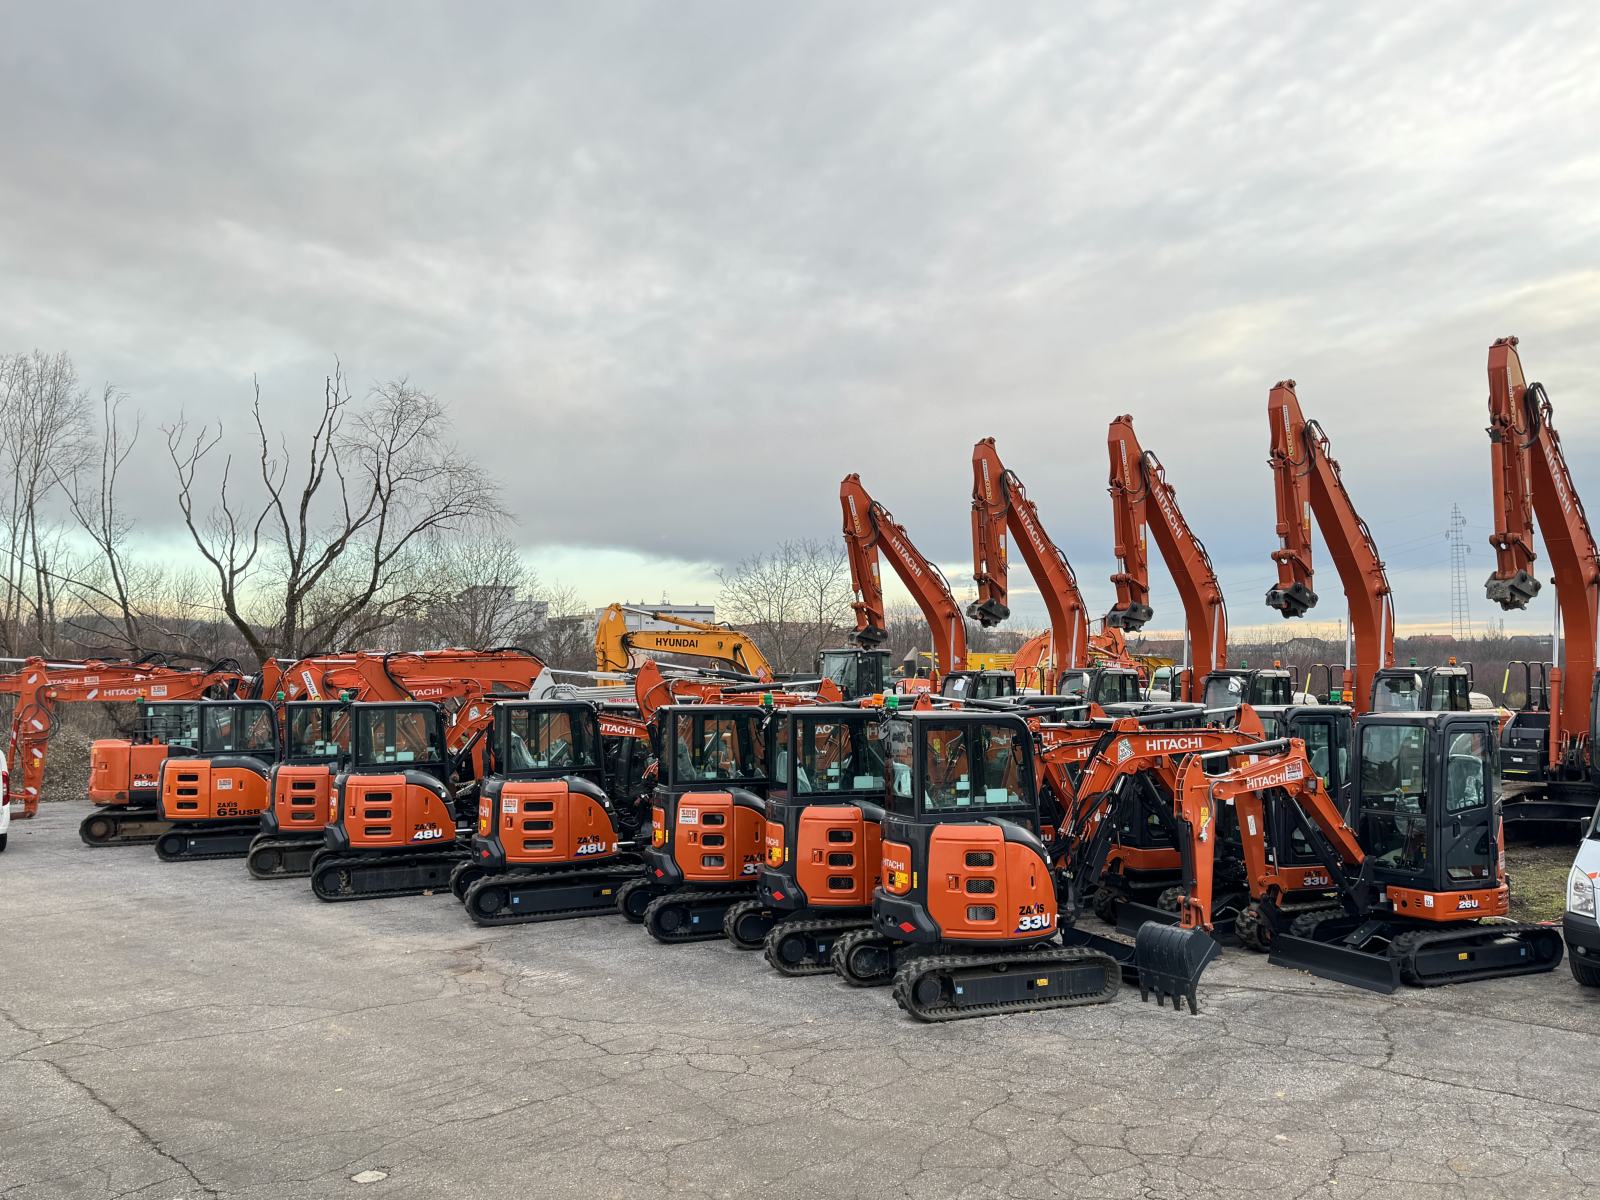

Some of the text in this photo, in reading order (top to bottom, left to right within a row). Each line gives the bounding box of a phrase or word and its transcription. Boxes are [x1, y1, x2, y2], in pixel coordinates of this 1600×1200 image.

[1544, 446, 1571, 514] HITACHI
[1154, 485, 1183, 540] HITACHI
[1017, 504, 1046, 554] HITACHI
[891, 536, 922, 578] HITACHI
[655, 637, 699, 649] HYUNDAI
[103, 688, 142, 697] HITACH
[410, 687, 443, 697] TACHI
[1145, 737, 1203, 751] HITACHI
[1246, 772, 1286, 789] HITACHI
[216, 807, 261, 816] 65USB
[413, 828, 443, 840] 48U
[576, 842, 606, 854] 48U
[1303, 876, 1329, 886] 33U
[1018, 903, 1045, 916] ZAXIS
[1458, 900, 1479, 909] 26U
[1018, 913, 1051, 931] 33U
